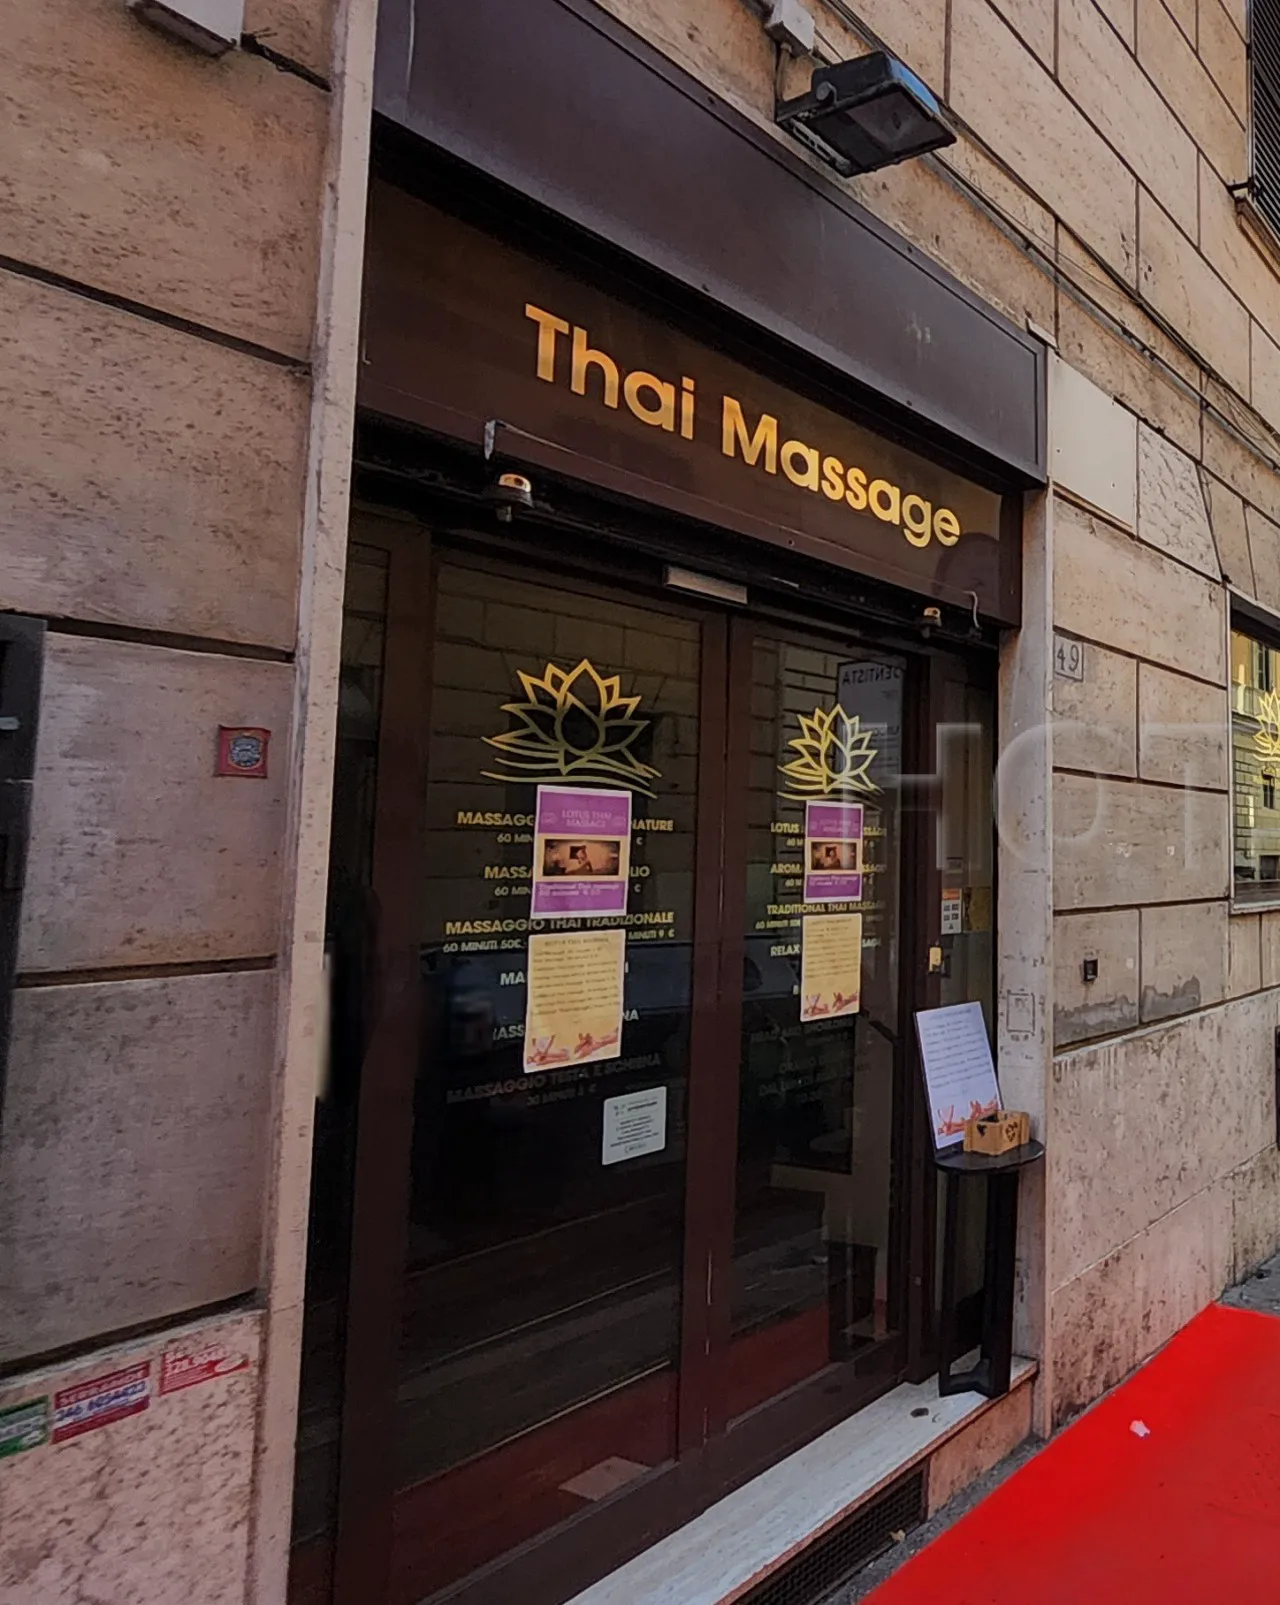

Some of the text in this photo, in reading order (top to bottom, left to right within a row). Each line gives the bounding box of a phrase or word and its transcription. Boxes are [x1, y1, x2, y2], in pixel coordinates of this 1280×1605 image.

[525, 303, 960, 548] Thai Massage
[1056, 643, 1080, 672] 49
[766, 903, 826, 916] TRADITIONAL
[828, 903, 847, 912] THAI
[446, 918, 545, 935] MASSAGGIO
[550, 917, 581, 929] THAI
[443, 942, 458, 953] 60
[460, 940, 498, 951] MINUTI
[770, 943, 801, 957] RELAX
